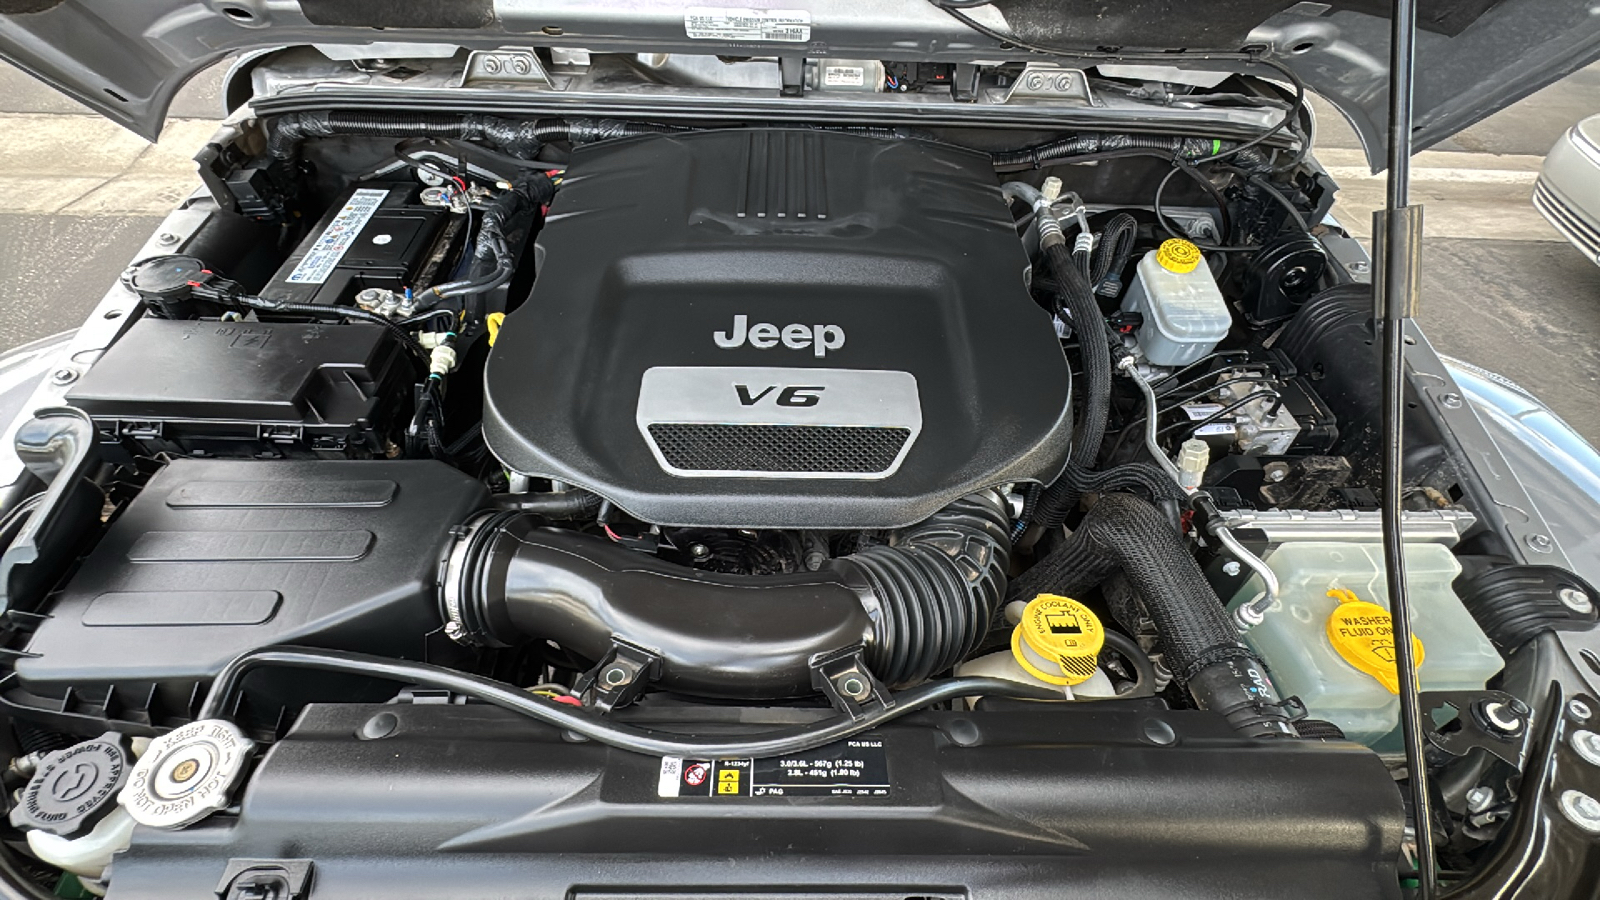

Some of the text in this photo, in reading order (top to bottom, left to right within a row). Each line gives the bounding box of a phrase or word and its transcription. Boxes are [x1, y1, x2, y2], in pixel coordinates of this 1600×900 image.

[713, 314, 846, 359] Jeep
[733, 384, 826, 407] V6
[1033, 601, 1094, 634] ENGINE COOLANT ONLY
[1339, 626, 1394, 637] FLUID ON
[1340, 616, 1392, 626] WASHER
[1247, 668, 1271, 698] RAD
[163, 724, 236, 750] KEEP TIGHT
[58, 744, 103, 764] POWER
[76, 763, 121, 814] APPROVED
[152, 796, 195, 816] OPEN
[198, 771, 226, 799] HOT
